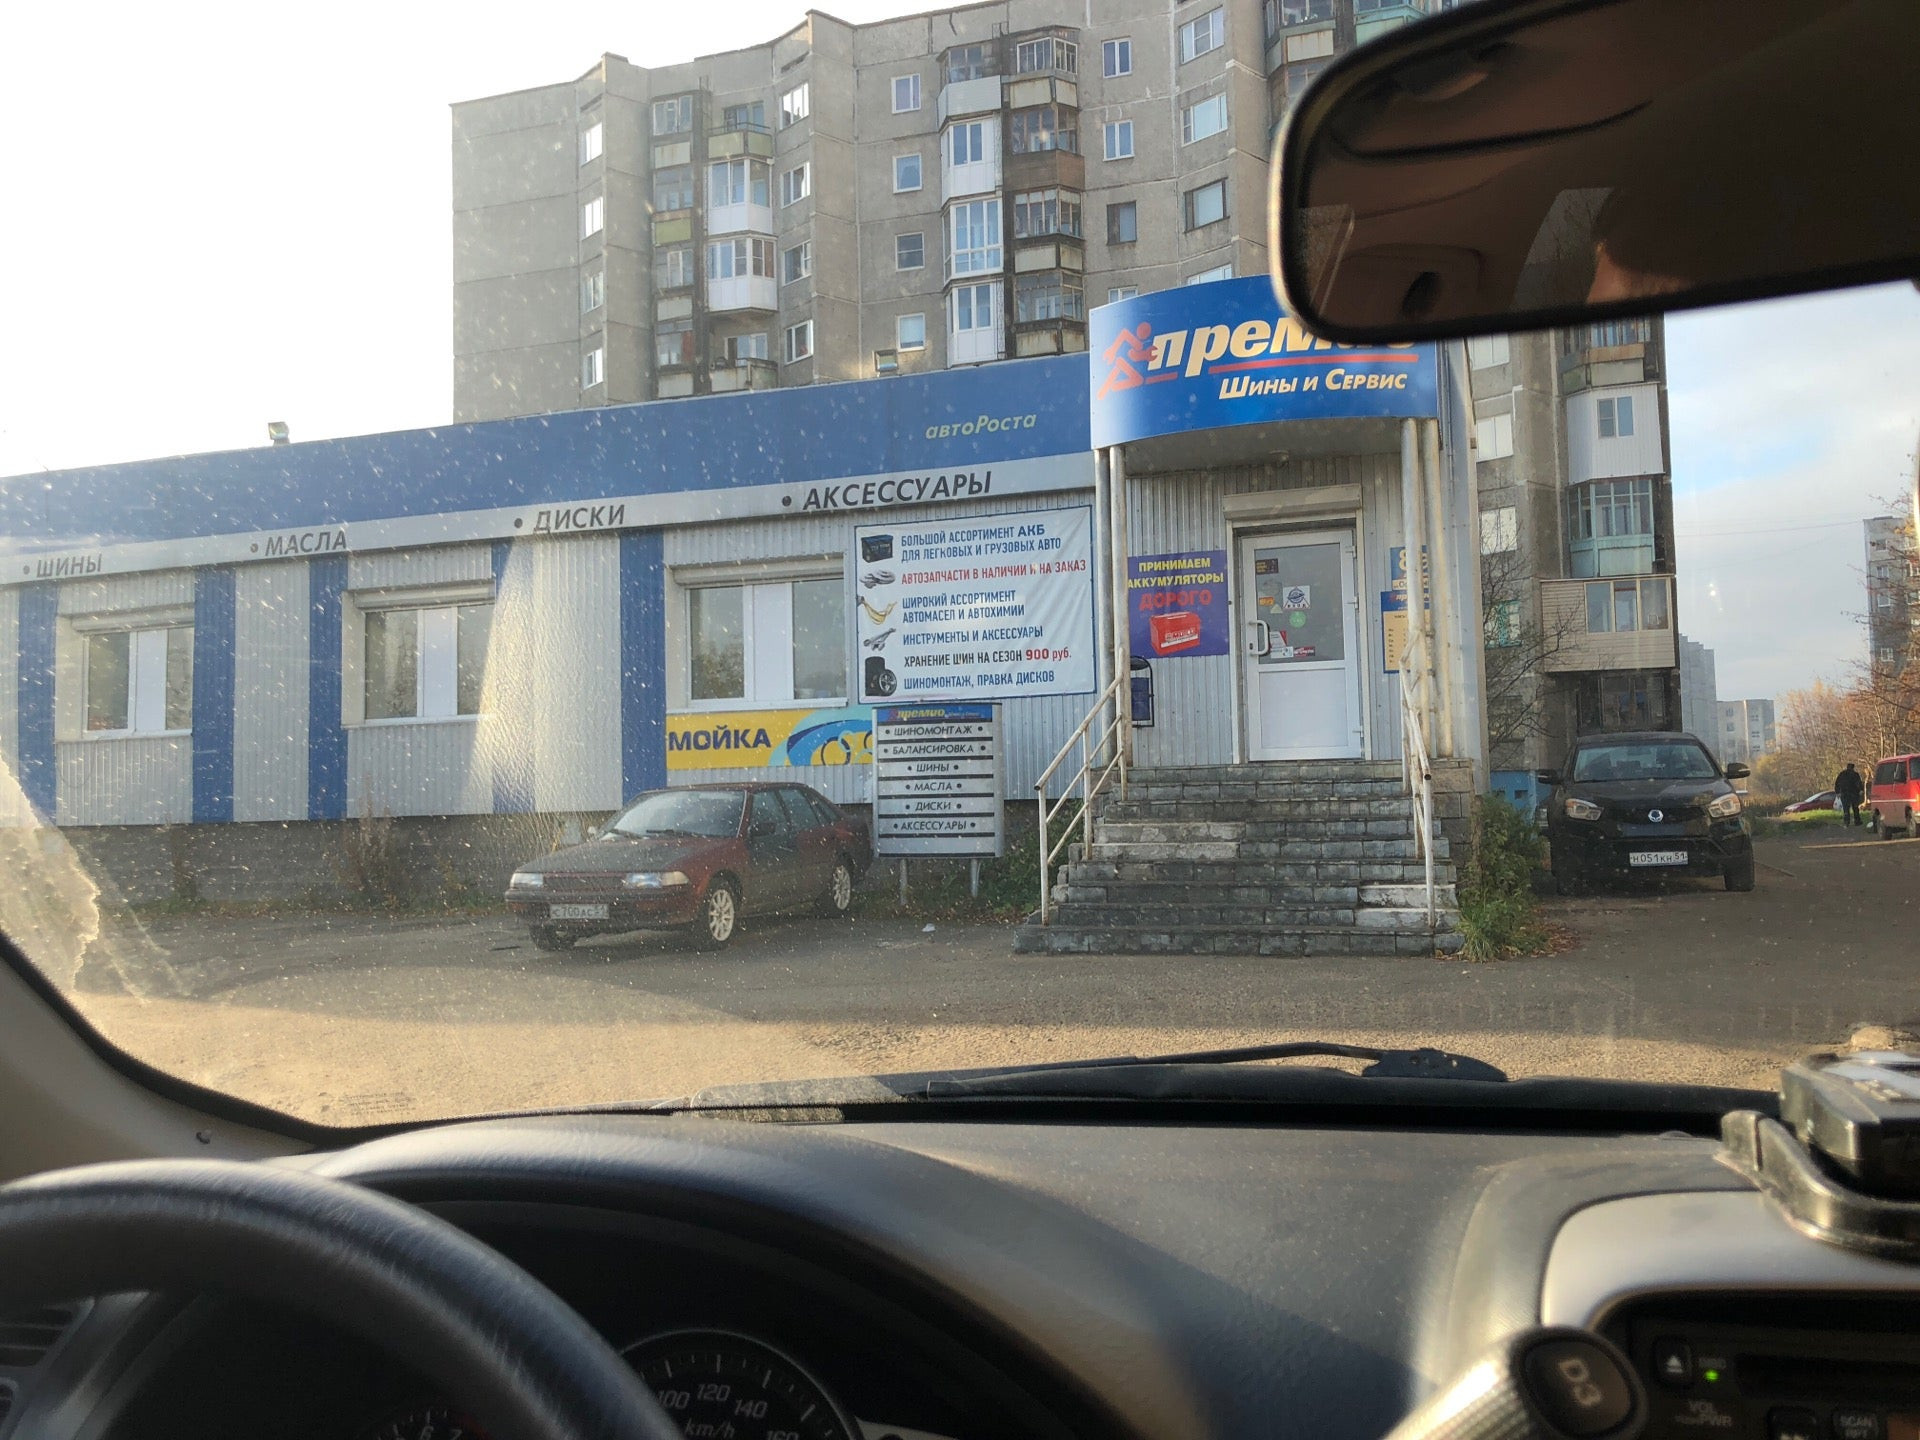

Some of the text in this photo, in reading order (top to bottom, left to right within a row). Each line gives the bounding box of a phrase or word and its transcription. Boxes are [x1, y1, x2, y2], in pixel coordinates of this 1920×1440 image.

[1148, 317, 1415, 377] прем
[803, 471, 991, 510] АКСЕССУАРЫ
[533, 504, 625, 534] ДИСКИ
[265, 530, 347, 557] МАСЛА
[901, 524, 1045, 547] БОЛЬШОЙ АССОРТИМЕНТ АКБ
[901, 537, 1061, 563] ДЛЯ ЛЕГКОВЫХ И ГРУЗОВЫХ АВТО
[36, 553, 101, 578] ШИНЫ
[901, 559, 1086, 585] АВТОЗАПЧАСТИ В НАЛИЧИИ И НА ЗАКАЗ
[1138, 557, 1211, 572] ПРИНИМАЕМ
[1128, 572, 1224, 588] АККУМУЛЯТОРЫ
[902, 590, 1016, 609] ШИРОКИЙ АССОРТИМЕНТ
[1139, 589, 1213, 611] ДОРОГО
[902, 604, 1025, 623] АВТОМАСЕЛ И АВТОХИМИИ
[903, 625, 1043, 645] ИНСТРУМЕНТЫ И АКСЕССУАРЫ
[904, 647, 1072, 667] ХРАНЕНИЕ ШИН НА СЕЗОН 900 руб.
[904, 670, 1055, 690] ШИНОМОНТАЖ, ПРАВКА ДИСКОВ
[668, 724, 772, 751] МОЙКА
[894, 725, 972, 736] ШИНОМОНТАЖ
[892, 744, 974, 755] БАЛАНСИРОВКА
[916, 763, 949, 772] ШИНЫ
[914, 781, 953, 791] МАСЛА
[915, 801, 951, 812] ДИСКИ
[901, 820, 967, 831] АКСЕССУАРЫ
[656, 1389, 690, 1410] 100
[697, 1383, 731, 1402] 120
[735, 1399, 768, 1419] 140
